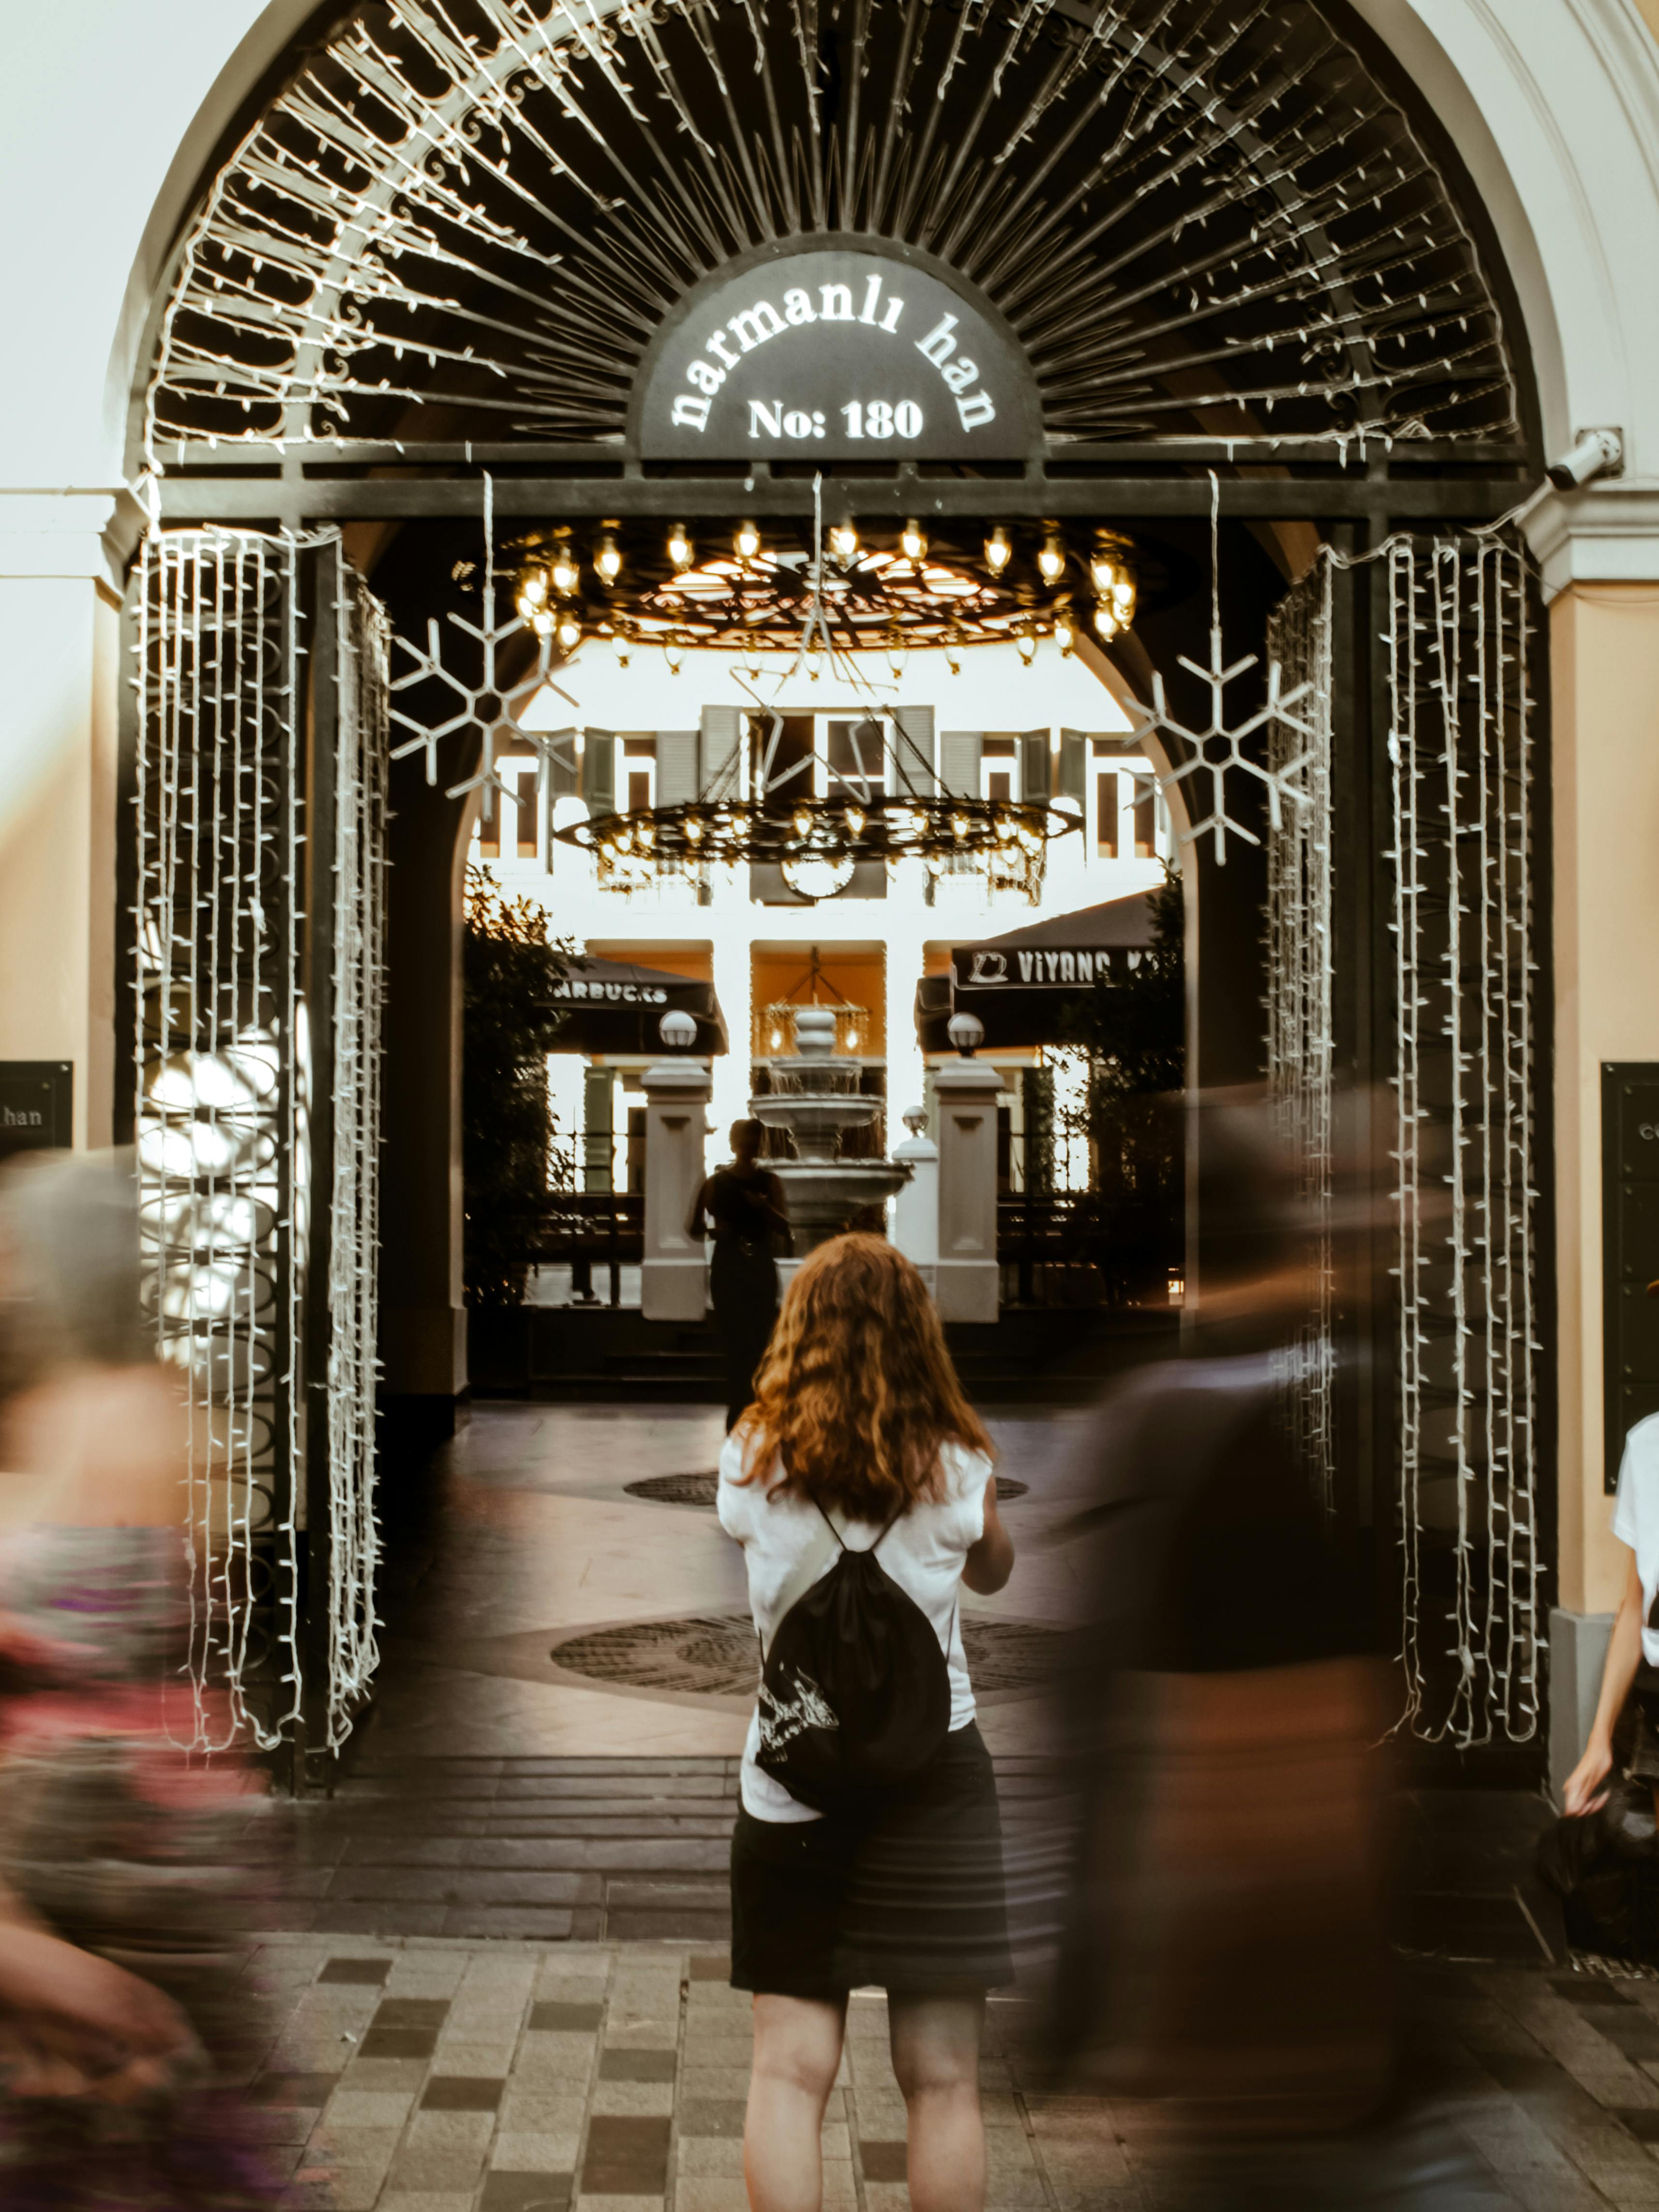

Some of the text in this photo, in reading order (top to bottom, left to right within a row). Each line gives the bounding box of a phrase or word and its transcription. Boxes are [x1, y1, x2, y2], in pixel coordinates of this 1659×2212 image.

[671, 273, 995, 432] narmanlı han
[748, 400, 923, 438] No: 180
[548, 980, 667, 1004] ARBUCKS
[3, 1105, 42, 1126] han
